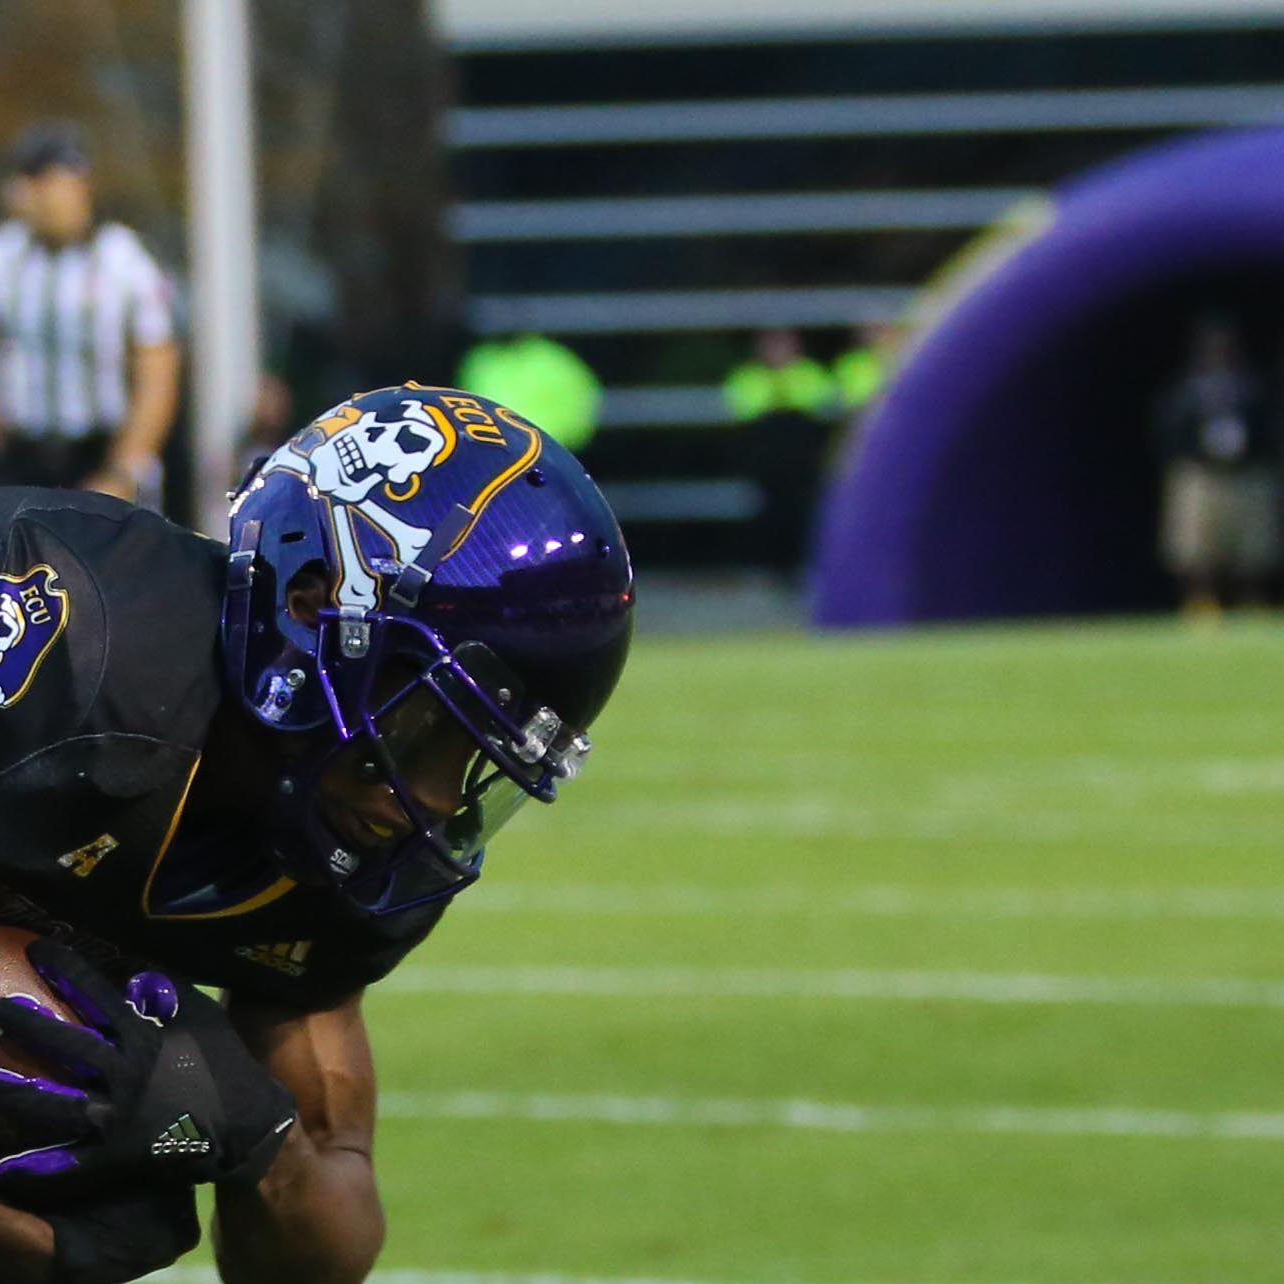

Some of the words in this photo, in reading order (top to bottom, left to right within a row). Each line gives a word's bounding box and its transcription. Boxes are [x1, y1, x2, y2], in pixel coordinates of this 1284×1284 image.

[439, 395, 508, 446] ECU
[19, 585, 52, 624] ECU
[152, 1137, 210, 1155] adidas
